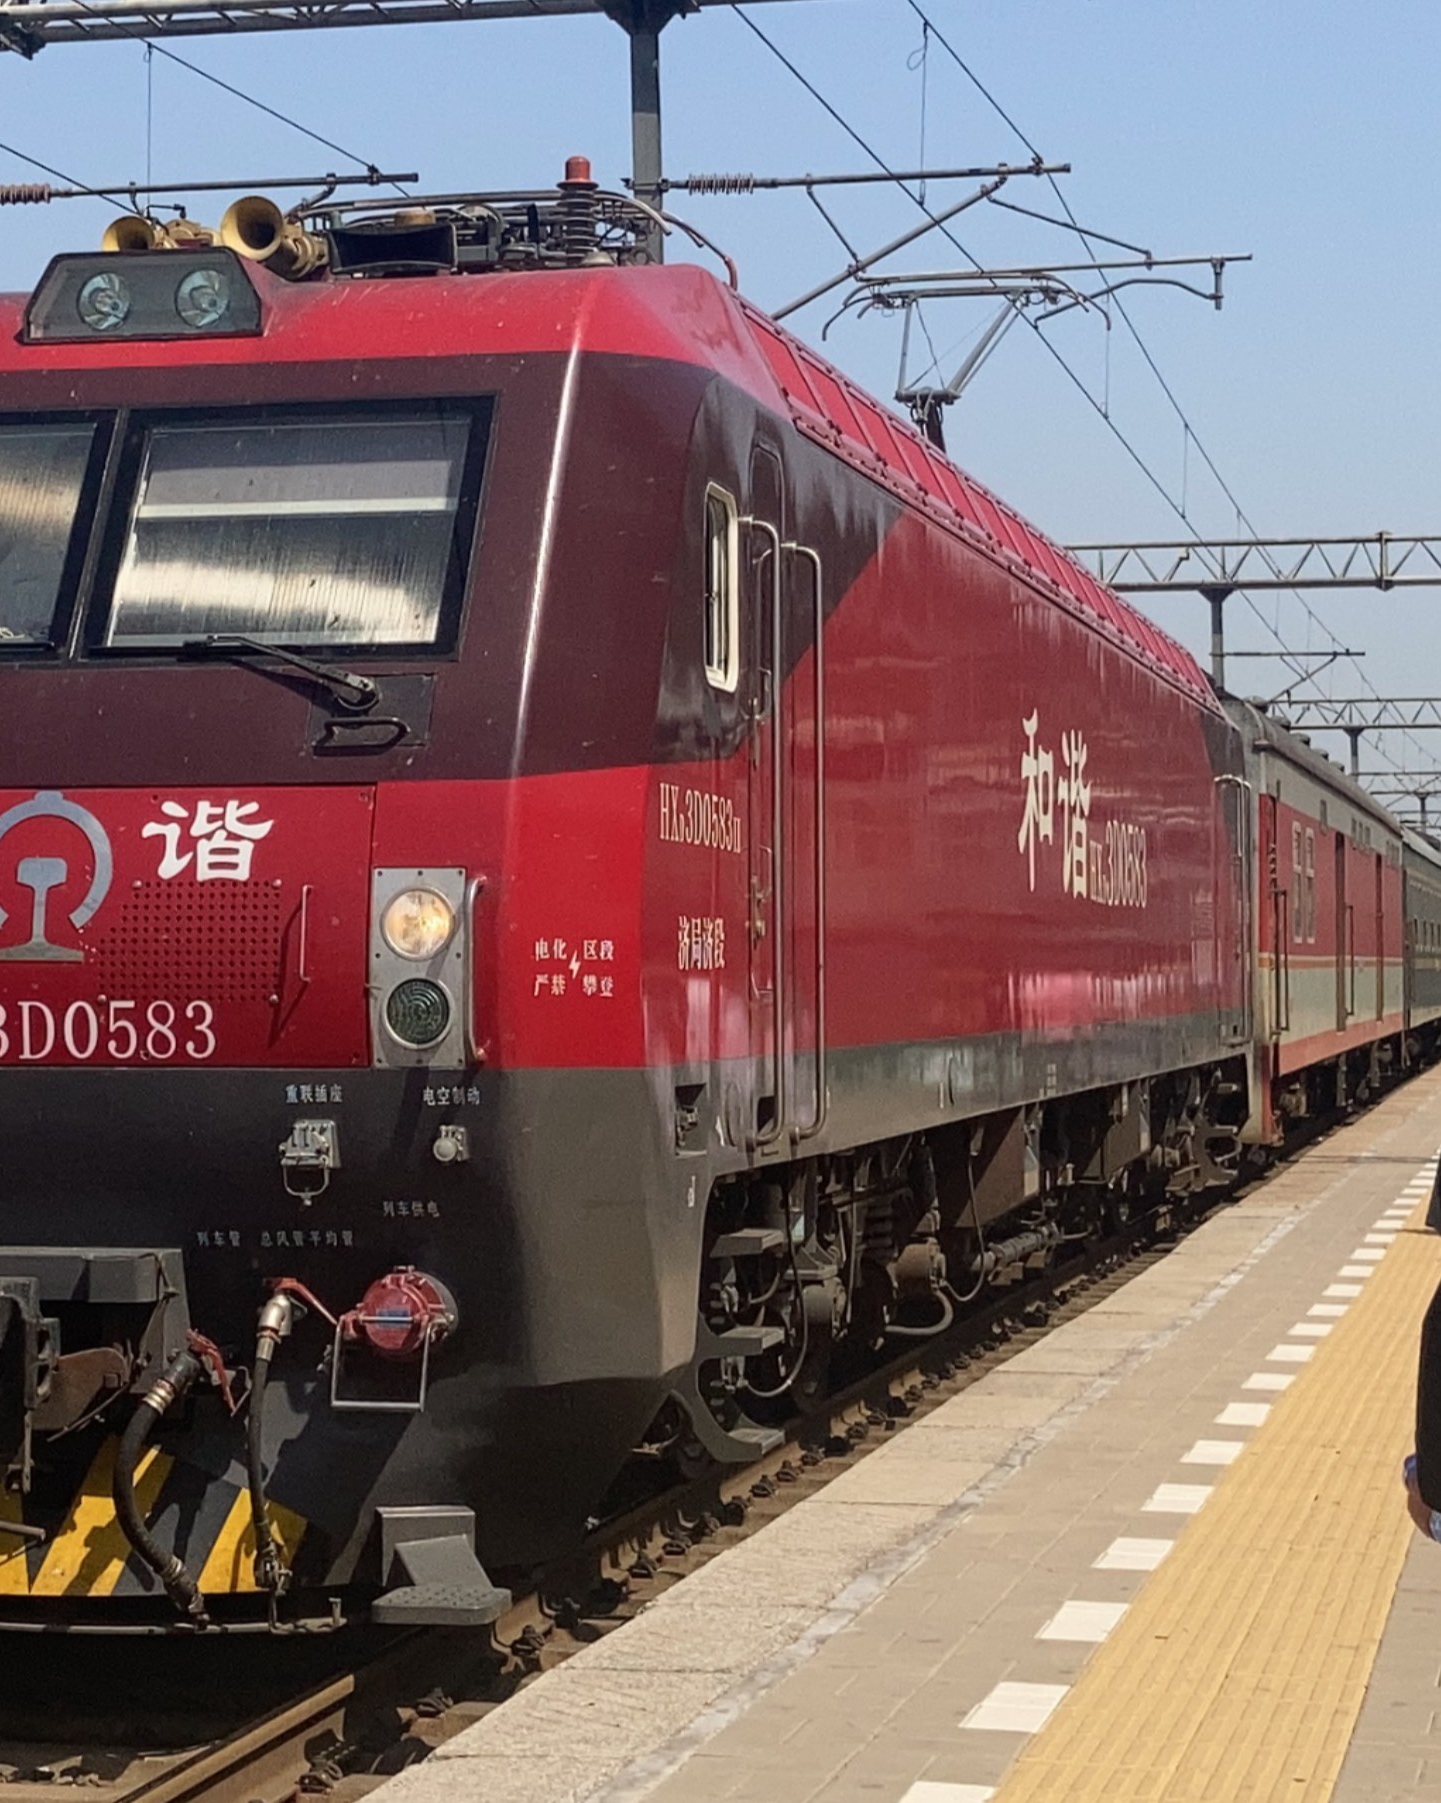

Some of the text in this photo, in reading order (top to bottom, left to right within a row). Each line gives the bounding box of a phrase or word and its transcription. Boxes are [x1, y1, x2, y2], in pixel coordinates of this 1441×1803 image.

[1018, 707, 1092, 900] 和谐
[141, 799, 276, 883] 谐
[583, 939, 614, 961] 区段
[677, 914, 726, 972] 济局济段
[533, 973, 566, 997] 严禁
[285, 1083, 343, 1104] 重联插座
[423, 1085, 480, 1107] 电空制动
